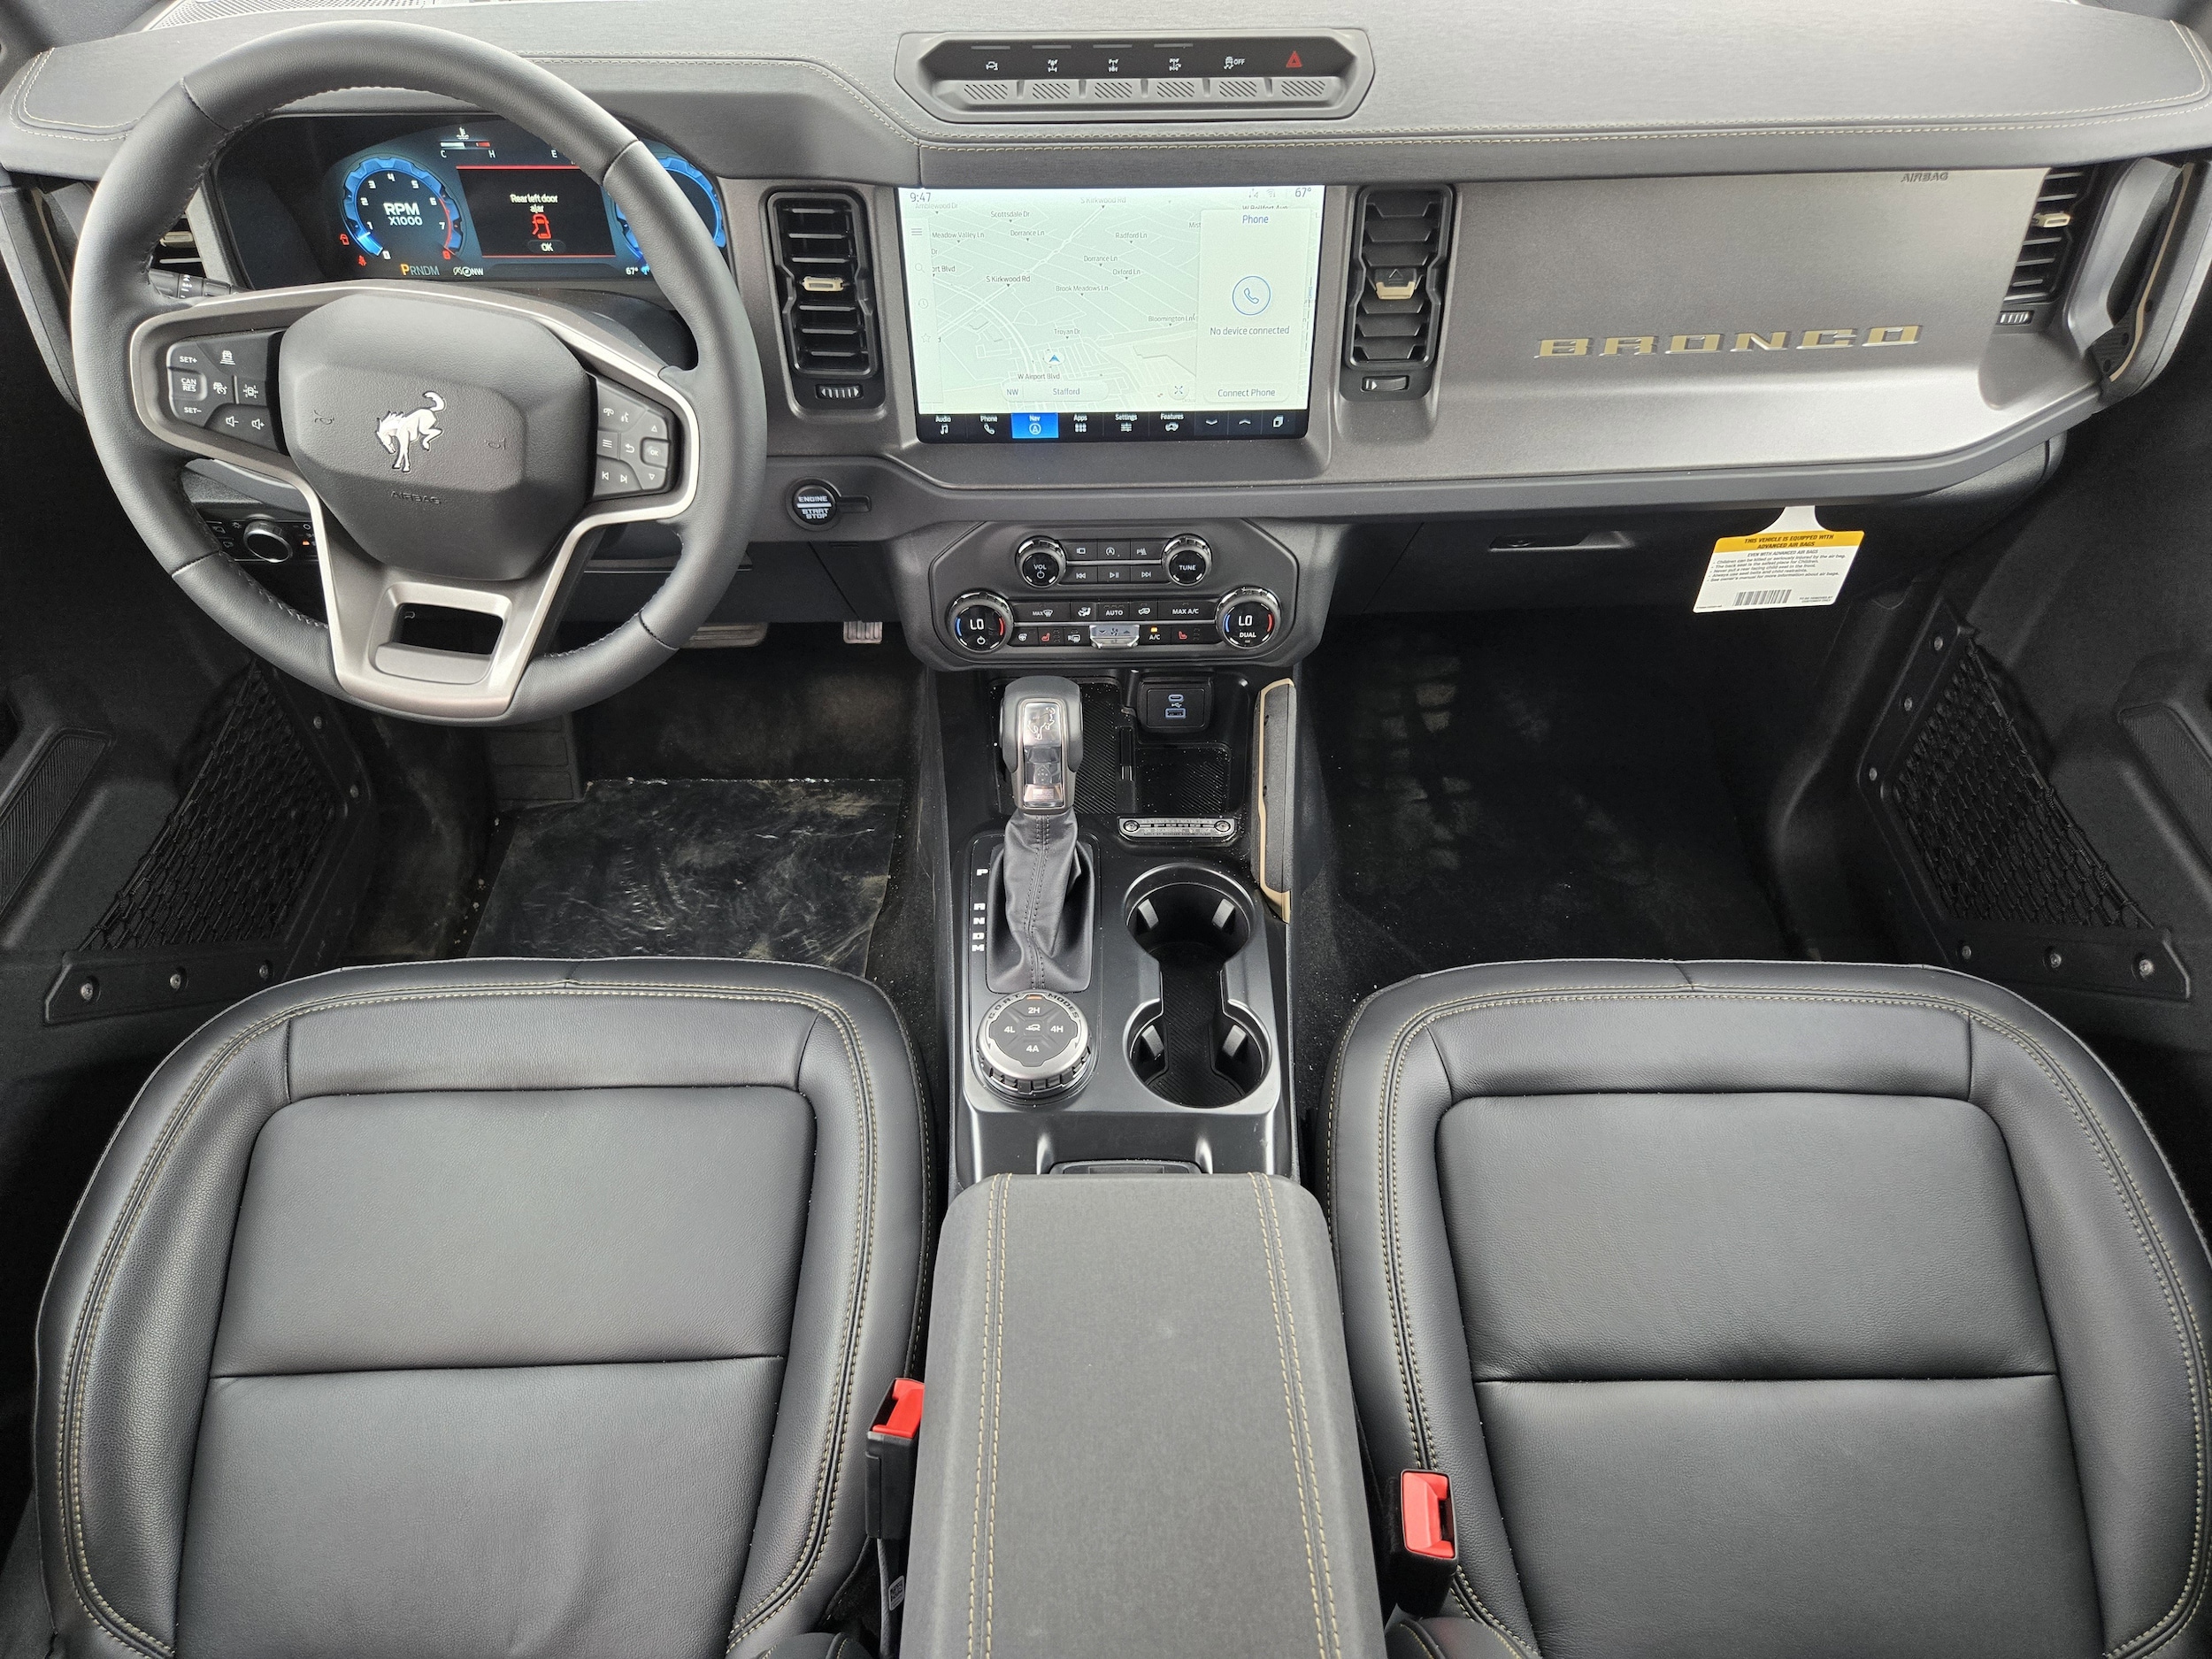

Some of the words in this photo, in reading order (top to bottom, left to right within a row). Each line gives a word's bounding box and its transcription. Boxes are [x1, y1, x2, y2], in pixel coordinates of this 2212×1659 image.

[1900, 172, 1948, 182] AIRBAG
[368, 180, 376, 189] 3
[1295, 187, 1311, 197] 67°
[360, 197, 368, 206] 2
[510, 194, 529, 203] Rear
[529, 194, 541, 203] left
[541, 194, 558, 203] door
[910, 192, 931, 202] 9:47
[383, 203, 420, 215] RPM
[530, 205, 544, 213] ajar
[388, 217, 423, 225] X1000
[1242, 215, 1269, 224] Phone
[541, 243, 554, 252] OK
[382, 251, 391, 259] 0
[1249, 326, 1290, 334] connected
[1534, 324, 1924, 359] BRONCO
[970, 619, 984, 630] LO
[1238, 615, 1252, 626] LO
[1048, 993, 1079, 1018] MODES
